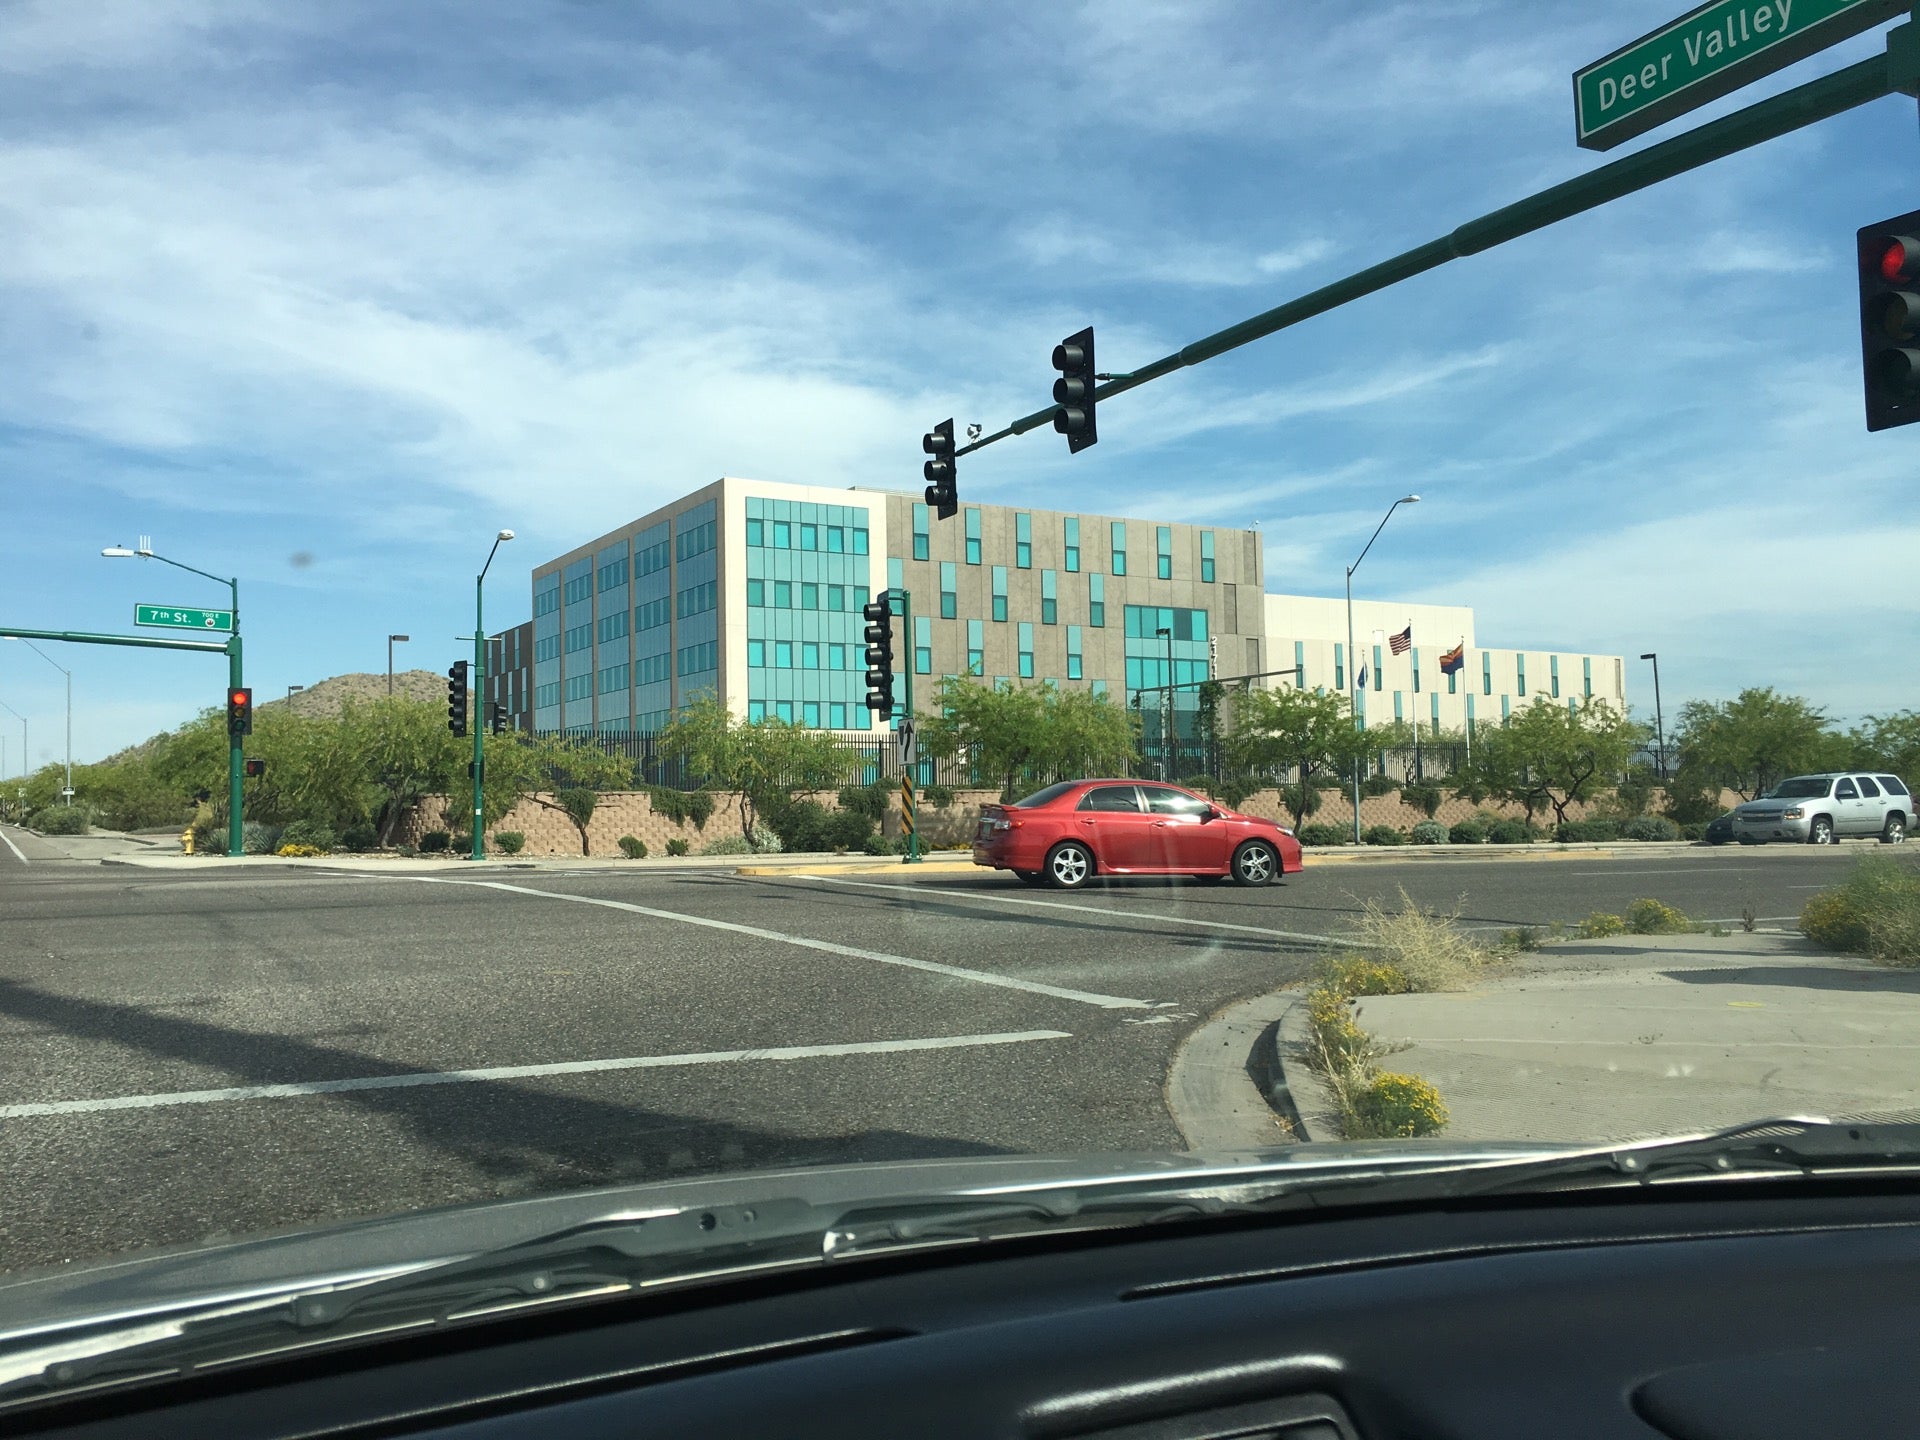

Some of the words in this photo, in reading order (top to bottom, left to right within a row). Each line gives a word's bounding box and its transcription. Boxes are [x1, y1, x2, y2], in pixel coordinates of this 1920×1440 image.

[1599, 53, 1672, 112] Deer
[1683, 0, 1792, 67] Valley
[150, 610, 170, 621] 7th
[174, 612, 191, 623] St.
